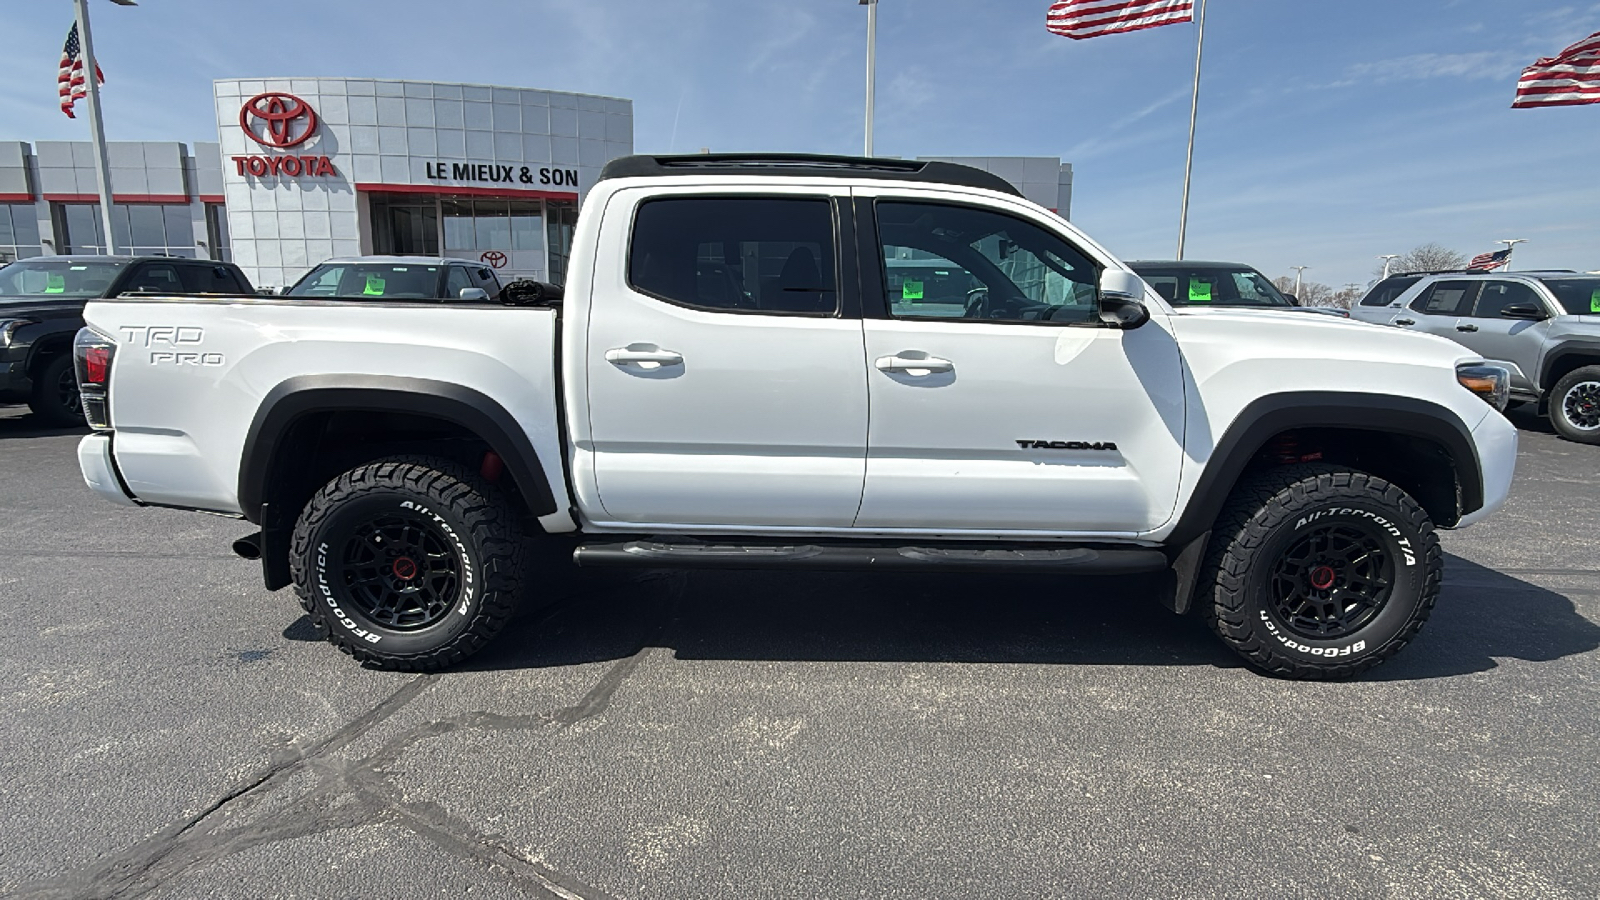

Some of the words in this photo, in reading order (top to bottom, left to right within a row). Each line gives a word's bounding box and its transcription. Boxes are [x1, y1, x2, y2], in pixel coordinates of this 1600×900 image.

[231, 155, 337, 177] TOYOTA
[426, 162, 447, 180] LE
[452, 163, 514, 183] MIEUX
[519, 166, 534, 184] &
[539, 168, 578, 187] SON
[119, 325, 206, 349] TRD
[150, 351, 226, 367] PRO
[1015, 440, 1118, 451] TACOMA
[1295, 507, 1401, 537] All-Terrain
[1398, 537, 1416, 567] T/A
[400, 500, 474, 583] All-Terrain
[458, 587, 475, 616] T/A
[316, 542, 382, 645] BFGoodrich
[1259, 610, 1366, 658] BFGoodrich
